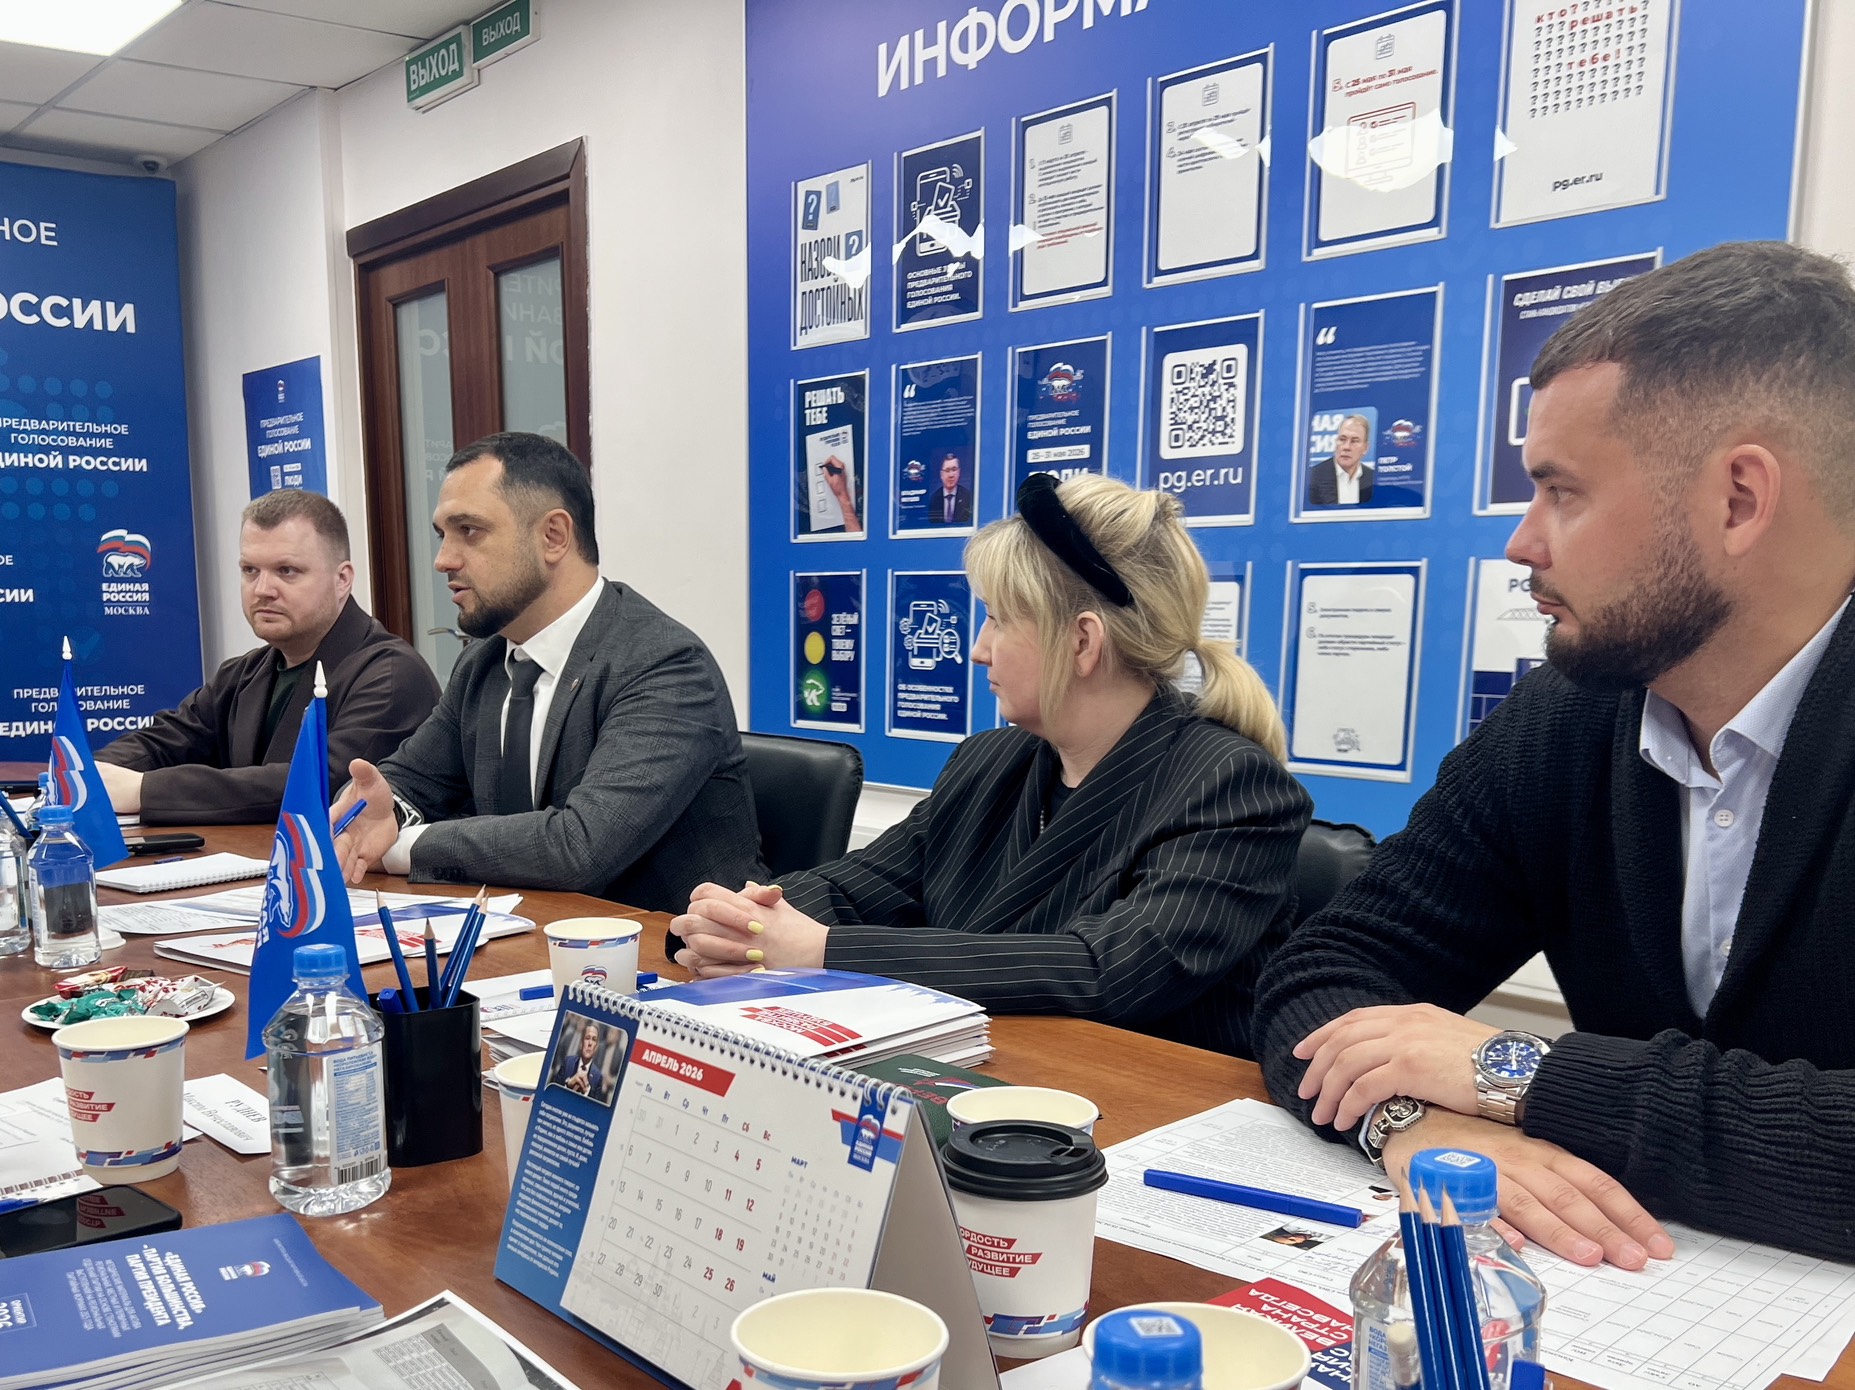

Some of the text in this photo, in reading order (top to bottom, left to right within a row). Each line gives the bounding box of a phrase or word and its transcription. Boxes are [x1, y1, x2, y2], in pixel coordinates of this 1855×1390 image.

[482, 12, 520, 46] ВЫХОД
[409, 42, 459, 91] ВЫХОД
[1387, 69, 1396, 77] 31
[1397, 66, 1413, 74] мая
[1552, 172, 1603, 192] pg.er.ru
[906, 284, 953, 299] ГОЛОСОВАНИЯ
[1513, 280, 1595, 307] СДЕЛАЙ СВОЙ
[906, 296, 932, 309] ЕДИНОЙ
[804, 386, 845, 408] РЕШАТЬ
[0, 417, 129, 435] РЕДВАРИТЕЛЬНОЕ
[804, 407, 829, 426] ТЕБЕ
[11, 433, 114, 449] ГОЛОСОВАНИЕ
[266, 425, 299, 438] ГОЛОСОВАНИЕ
[1027, 425, 1092, 440] ЕДИНОЙ РОССИИ
[258, 438, 311, 458] ЕДИНОЙ РОССИИ
[1068, 448, 1085, 456] 2026
[68, 455, 148, 473] РОССИИ
[1159, 467, 1243, 493] pg.er.ru
[102, 582, 149, 592] ЕДИНАЯ
[102, 592, 150, 602] РОССИЯ
[104, 606, 150, 615] МОСКВА
[13, 684, 145, 699] ПРЕДВИТЕЛЬНОЕ
[31, 699, 130, 713] ГОЛОВАНИЕ
[642, 1049, 704, 1081] АПРЕЛЬ 2026
[645, 1084, 771, 1141] Пн Вт Ср Чт Пт Сб Вс
[675, 1124, 680, 1136] 1
[693, 1132, 700, 1145] 2
[713, 1140, 720, 1153] 3
[734, 1149, 740, 1162] 4
[756, 1158, 761, 1171] 5
[791, 1156, 808, 1169] МАРТ
[628, 1144, 755, 1212] 6 7 8 9 10 11 12
[619, 1180, 745, 1251] 13 14 15 16 17 18 19
[959, 1228, 1008, 1248] ОРДОСТЬ
[608, 1217, 735, 1292] 20 21 22 23 24 25 26
[971, 1246, 1032, 1263] РАЗВИТИЕ
[597, 1253, 607, 1265] 27
[615, 1262, 625, 1276] 28
[633, 1272, 644, 1287] 29
[652, 1282, 663, 1297] 30
[762, 1271, 776, 1283] МАЙ
[968, 1260, 1010, 1276] УДУЩЕЕ
[124, 1253, 172, 1326] ПАРТИЯ ПРЕЗИДЕНТА
[140, 1247, 196, 1329] ПАРТИЯ БОЛЬШИНСТВА,
[160, 1251, 208, 1314] «ЕДИНАЯ РОССИЯ»
[9, 1298, 26, 1324] ОРИЕНТИР
[1249, 1288, 1353, 1332] НАВСЕГДА
[1261, 1303, 1349, 1340] СТРАНА
[1369, 1326, 1387, 1338] ВОДА
